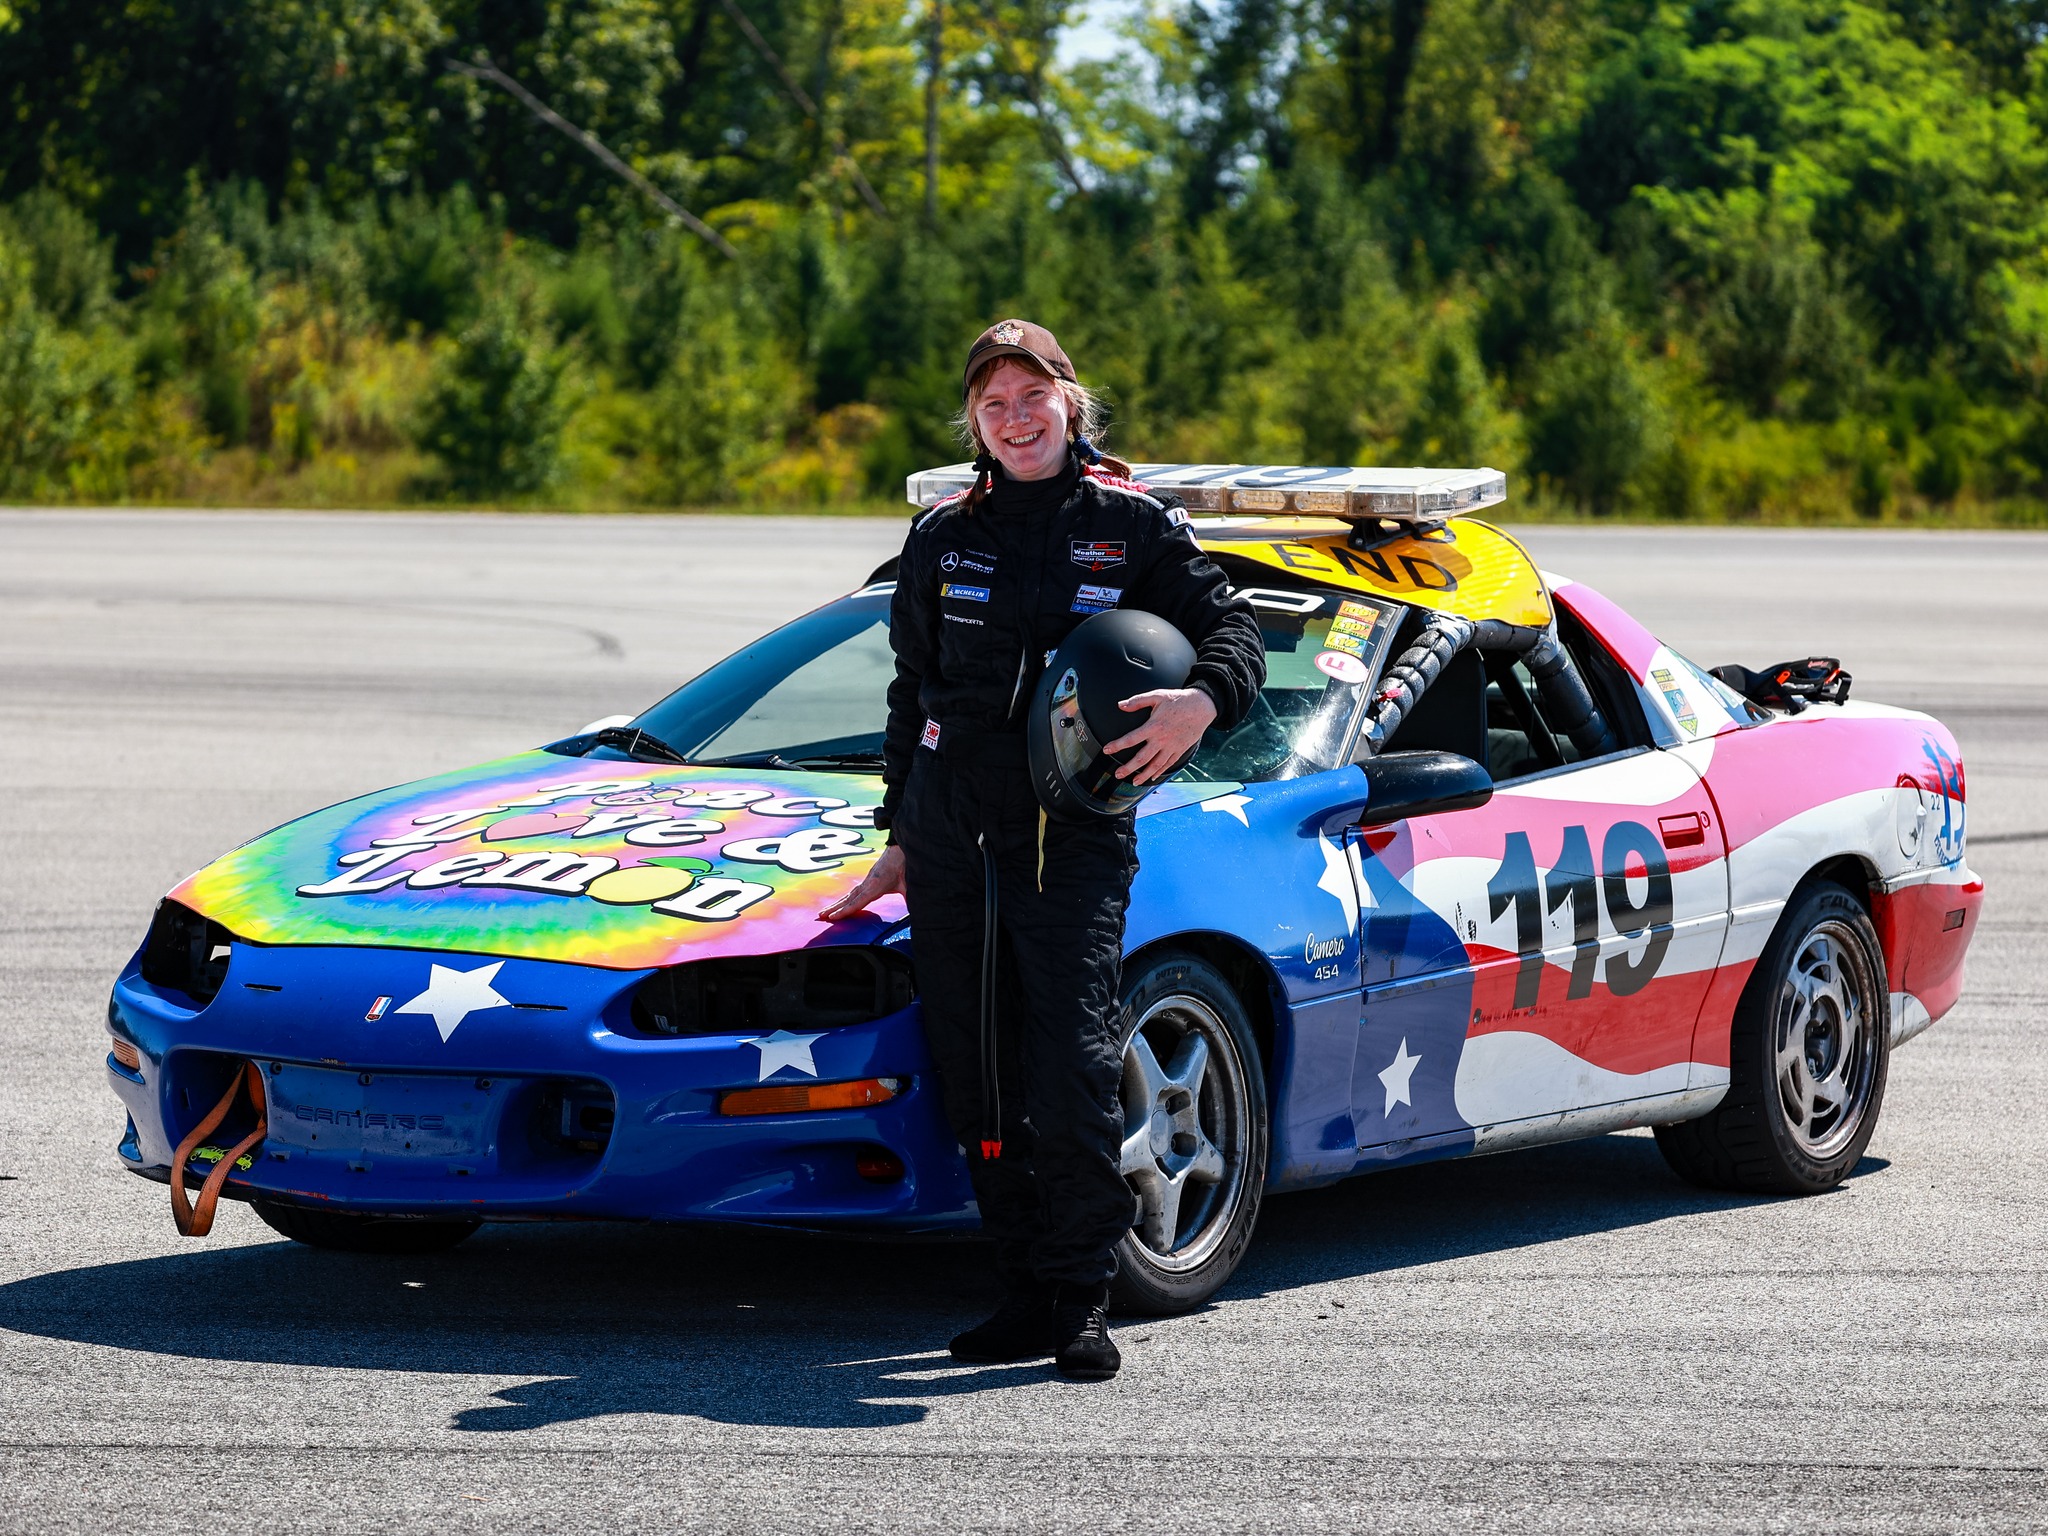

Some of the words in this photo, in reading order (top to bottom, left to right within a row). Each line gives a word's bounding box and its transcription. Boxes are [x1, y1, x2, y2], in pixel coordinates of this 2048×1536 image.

[1269, 543, 1459, 592] END
[927, 725, 939, 738] OMP
[1931, 795, 1941, 811] 22
[1487, 821, 1674, 1010] 119
[1155, 966, 1192, 981] OUTSIDE
[1314, 963, 1340, 980] 454
[295, 1104, 445, 1131] CAMARO
